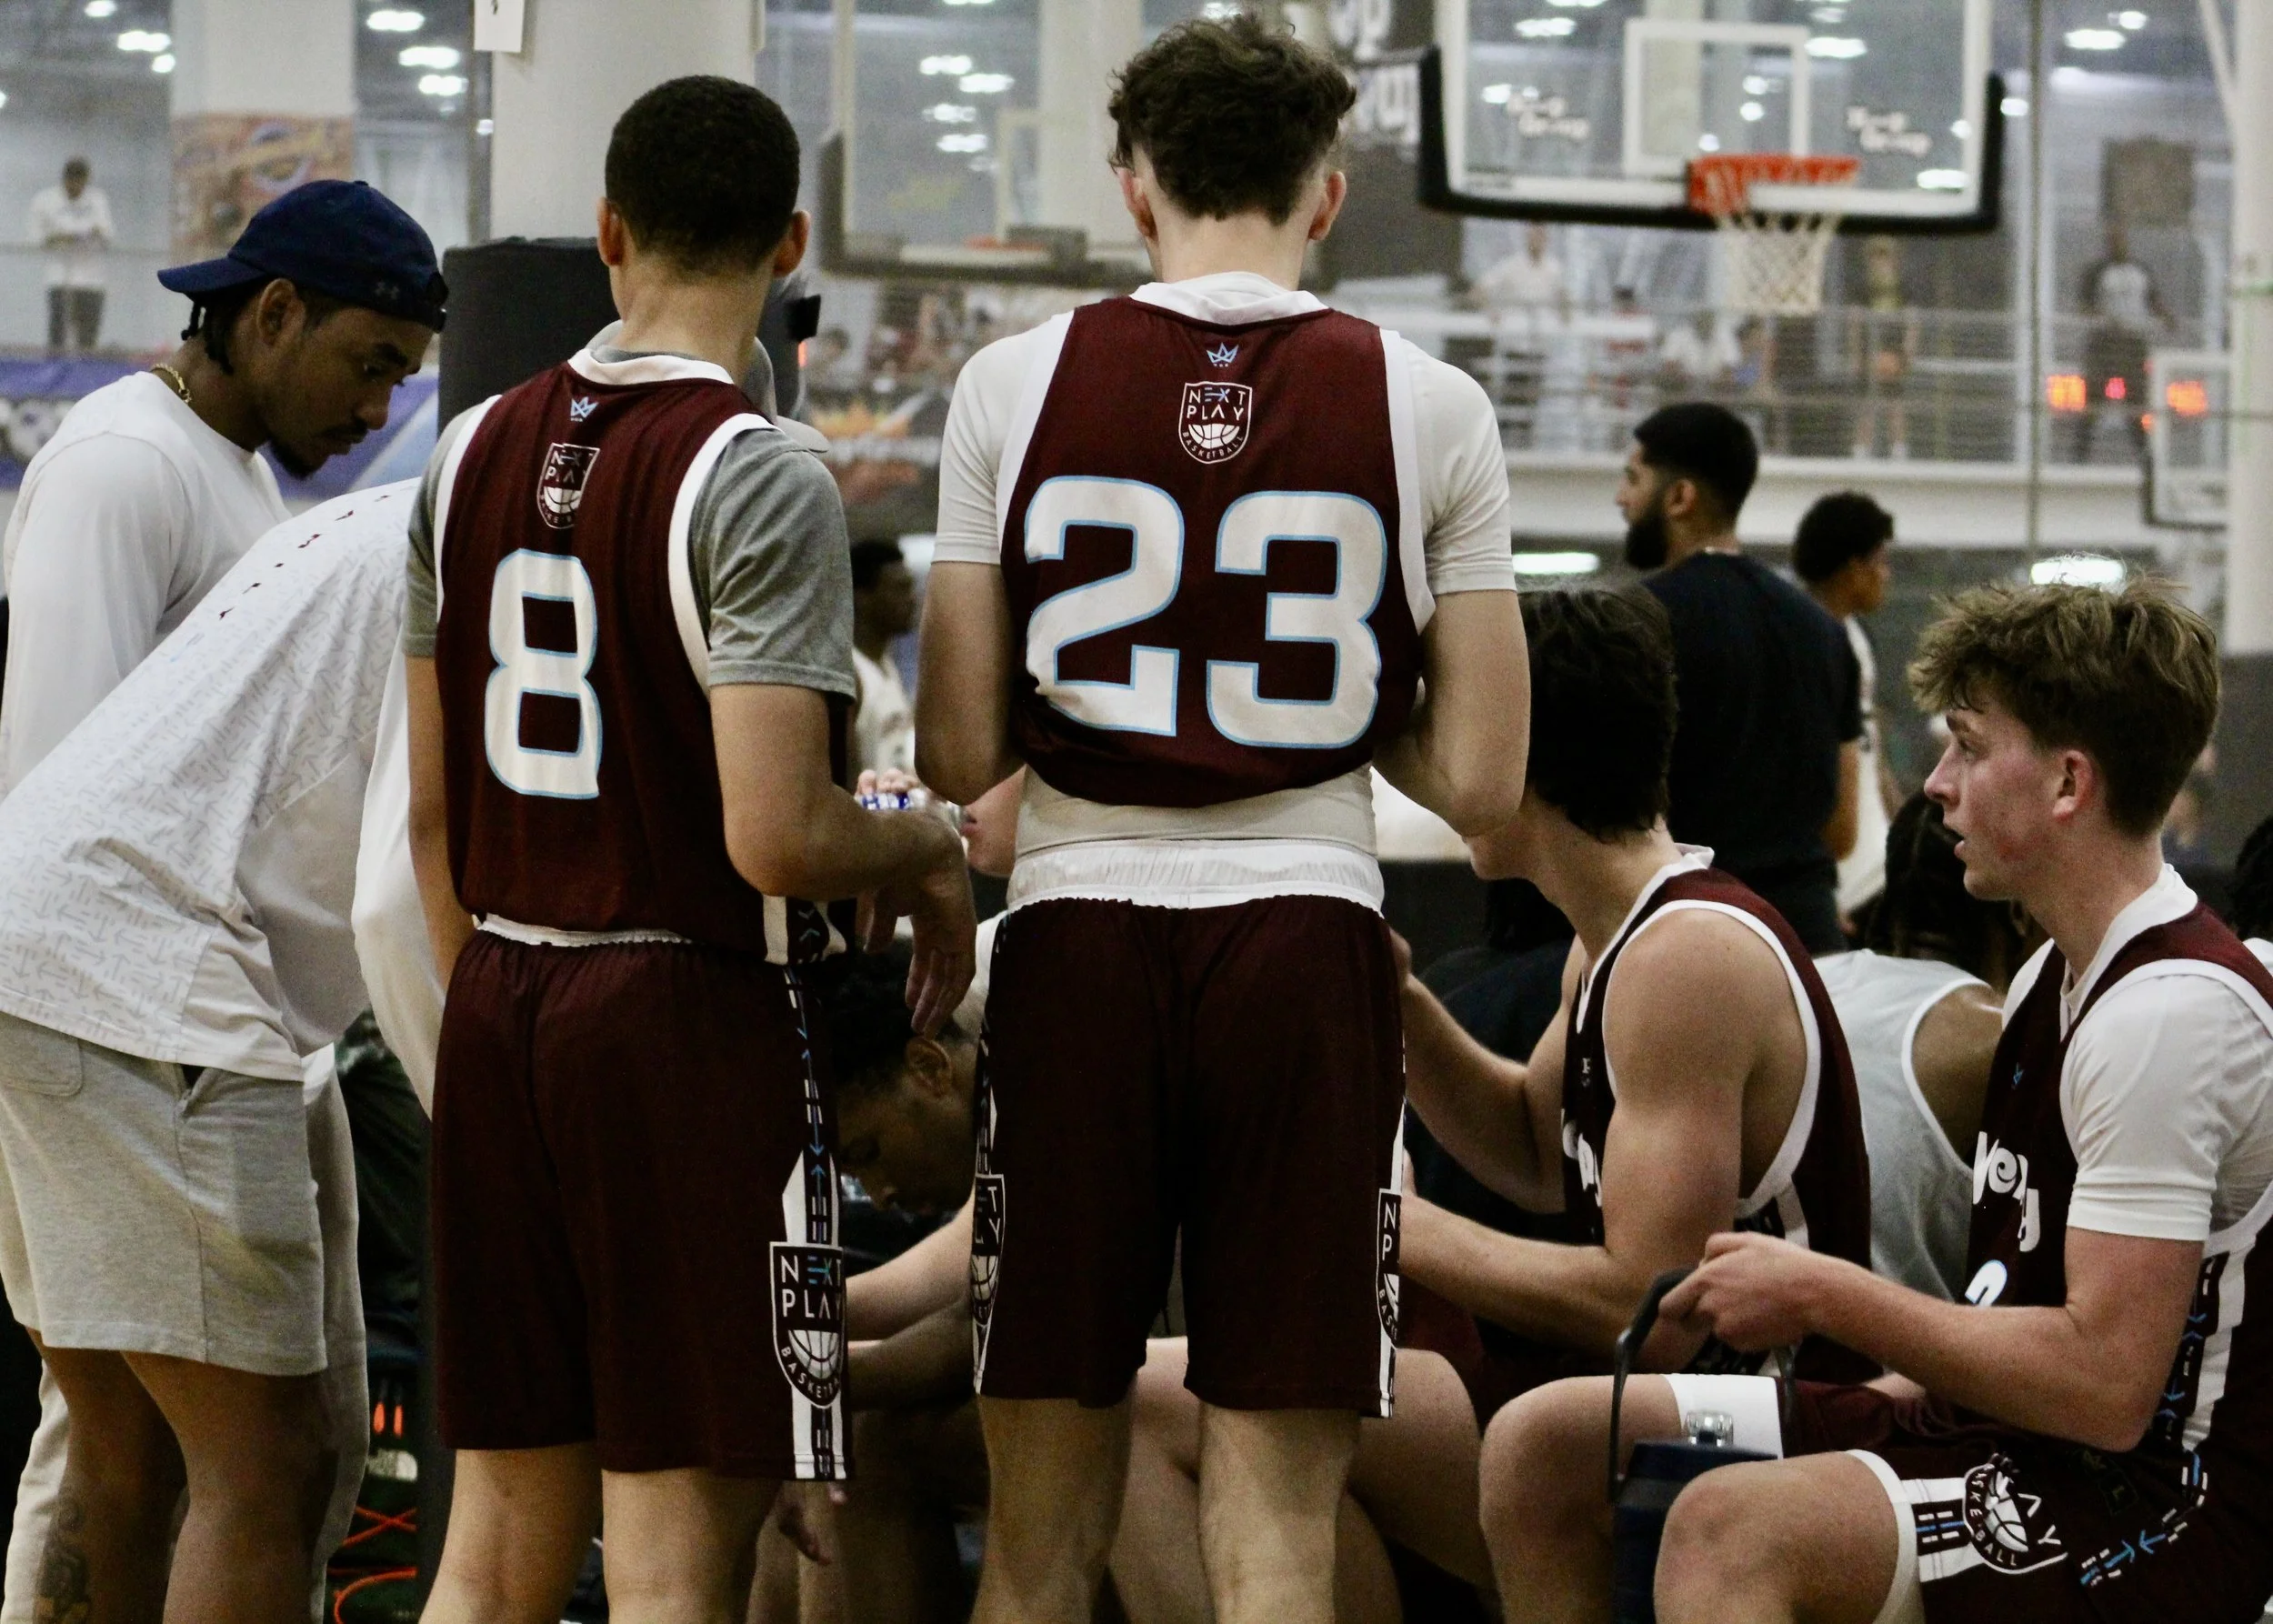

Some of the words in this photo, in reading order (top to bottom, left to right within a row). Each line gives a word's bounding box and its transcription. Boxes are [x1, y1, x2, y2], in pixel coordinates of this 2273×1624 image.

[1188, 386, 1246, 406] NEXT
[1187, 404, 1244, 421] PLAY
[1182, 431, 1244, 460] BASKETBALL
[1024, 475, 1388, 750] 23
[485, 547, 604, 800] 8
[780, 1254, 842, 1286] NEXT
